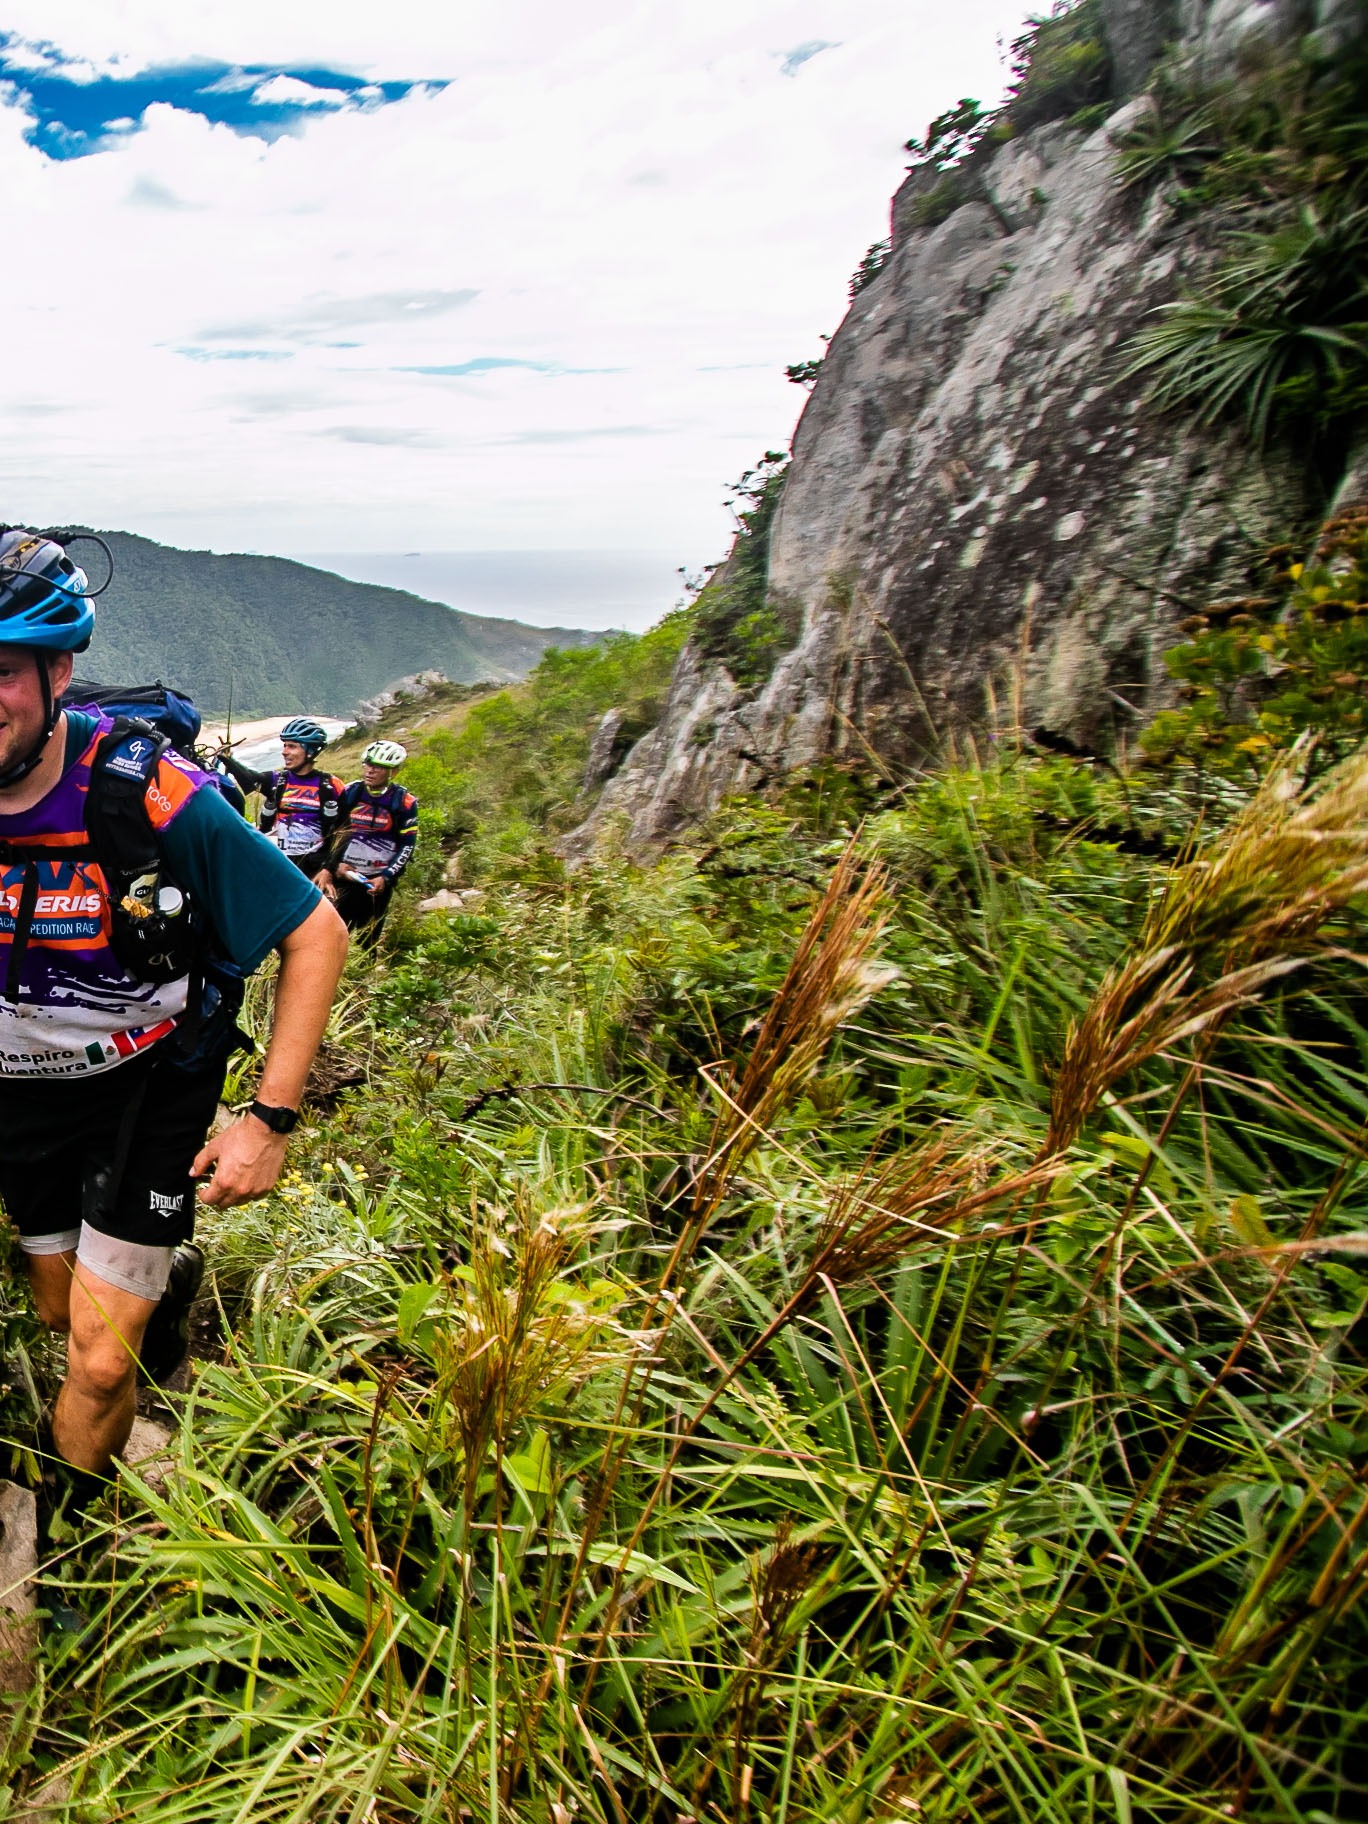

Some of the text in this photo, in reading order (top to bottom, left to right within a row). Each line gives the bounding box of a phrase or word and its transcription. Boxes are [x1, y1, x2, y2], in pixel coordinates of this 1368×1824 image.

[34, 893, 101, 913] ERIS
[30, 922, 74, 935] PEDITION
[149, 1190, 184, 1212] EVERLAST
